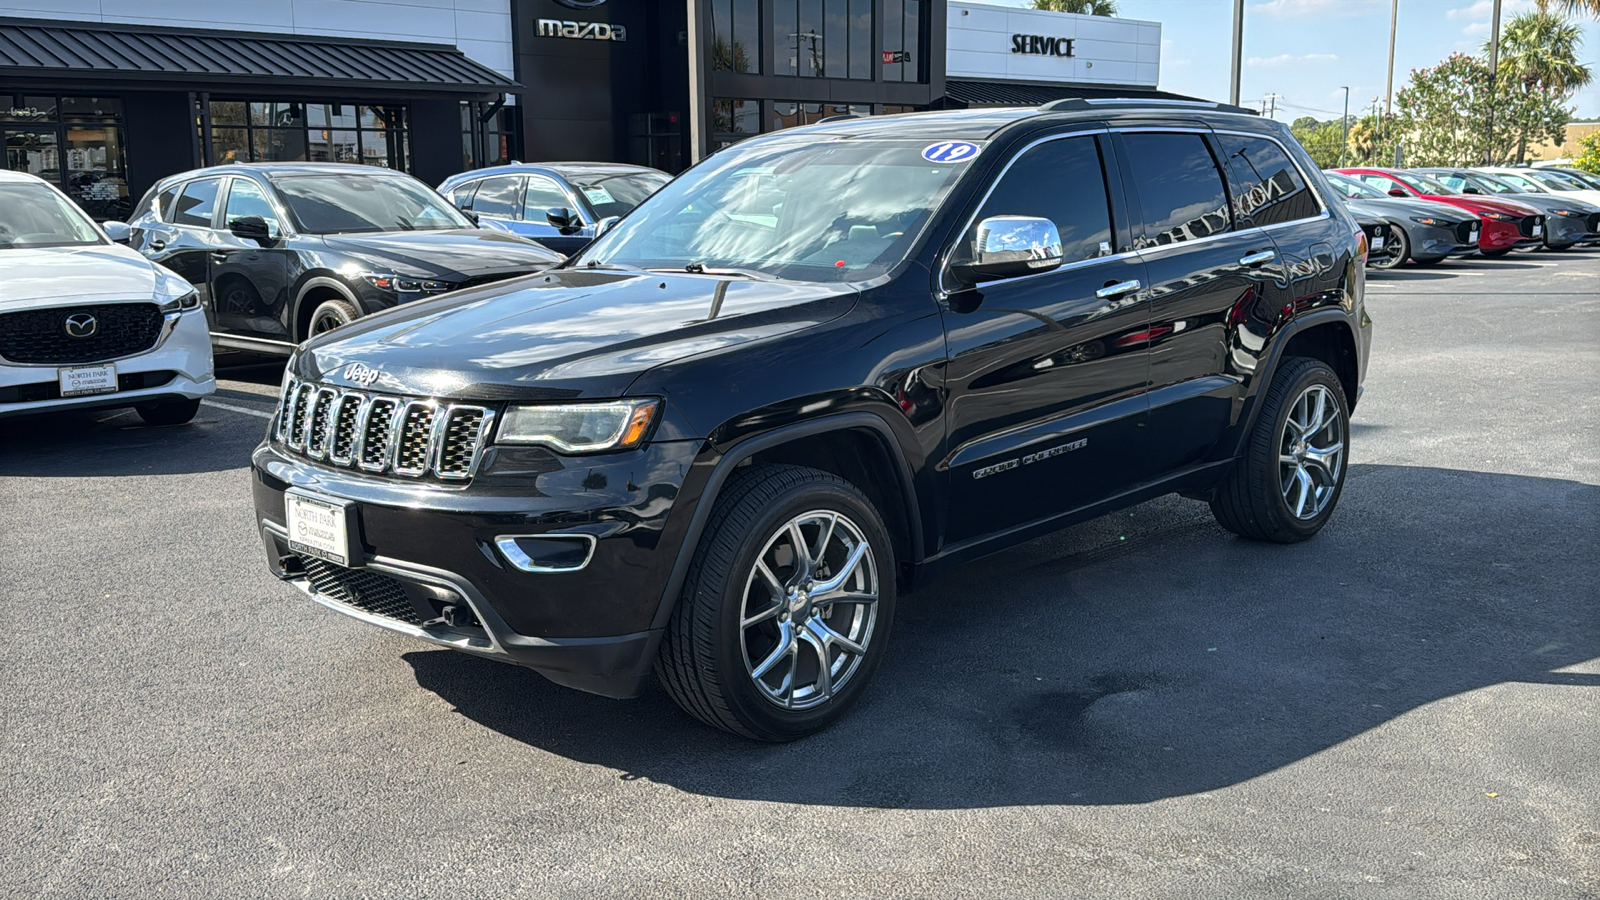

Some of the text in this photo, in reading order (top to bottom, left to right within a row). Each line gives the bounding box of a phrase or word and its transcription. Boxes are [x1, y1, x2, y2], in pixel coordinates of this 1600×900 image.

[1011, 33, 1076, 58] SERVICE
[929, 143, 972, 161] 19
[68, 372, 91, 380] NORTH
[343, 362, 380, 387] Jeep
[973, 438, 1088, 480] GRAND CHEROKEE
[294, 507, 337, 528] NORTH PARK
[291, 542, 321, 557] NORTH PARK
